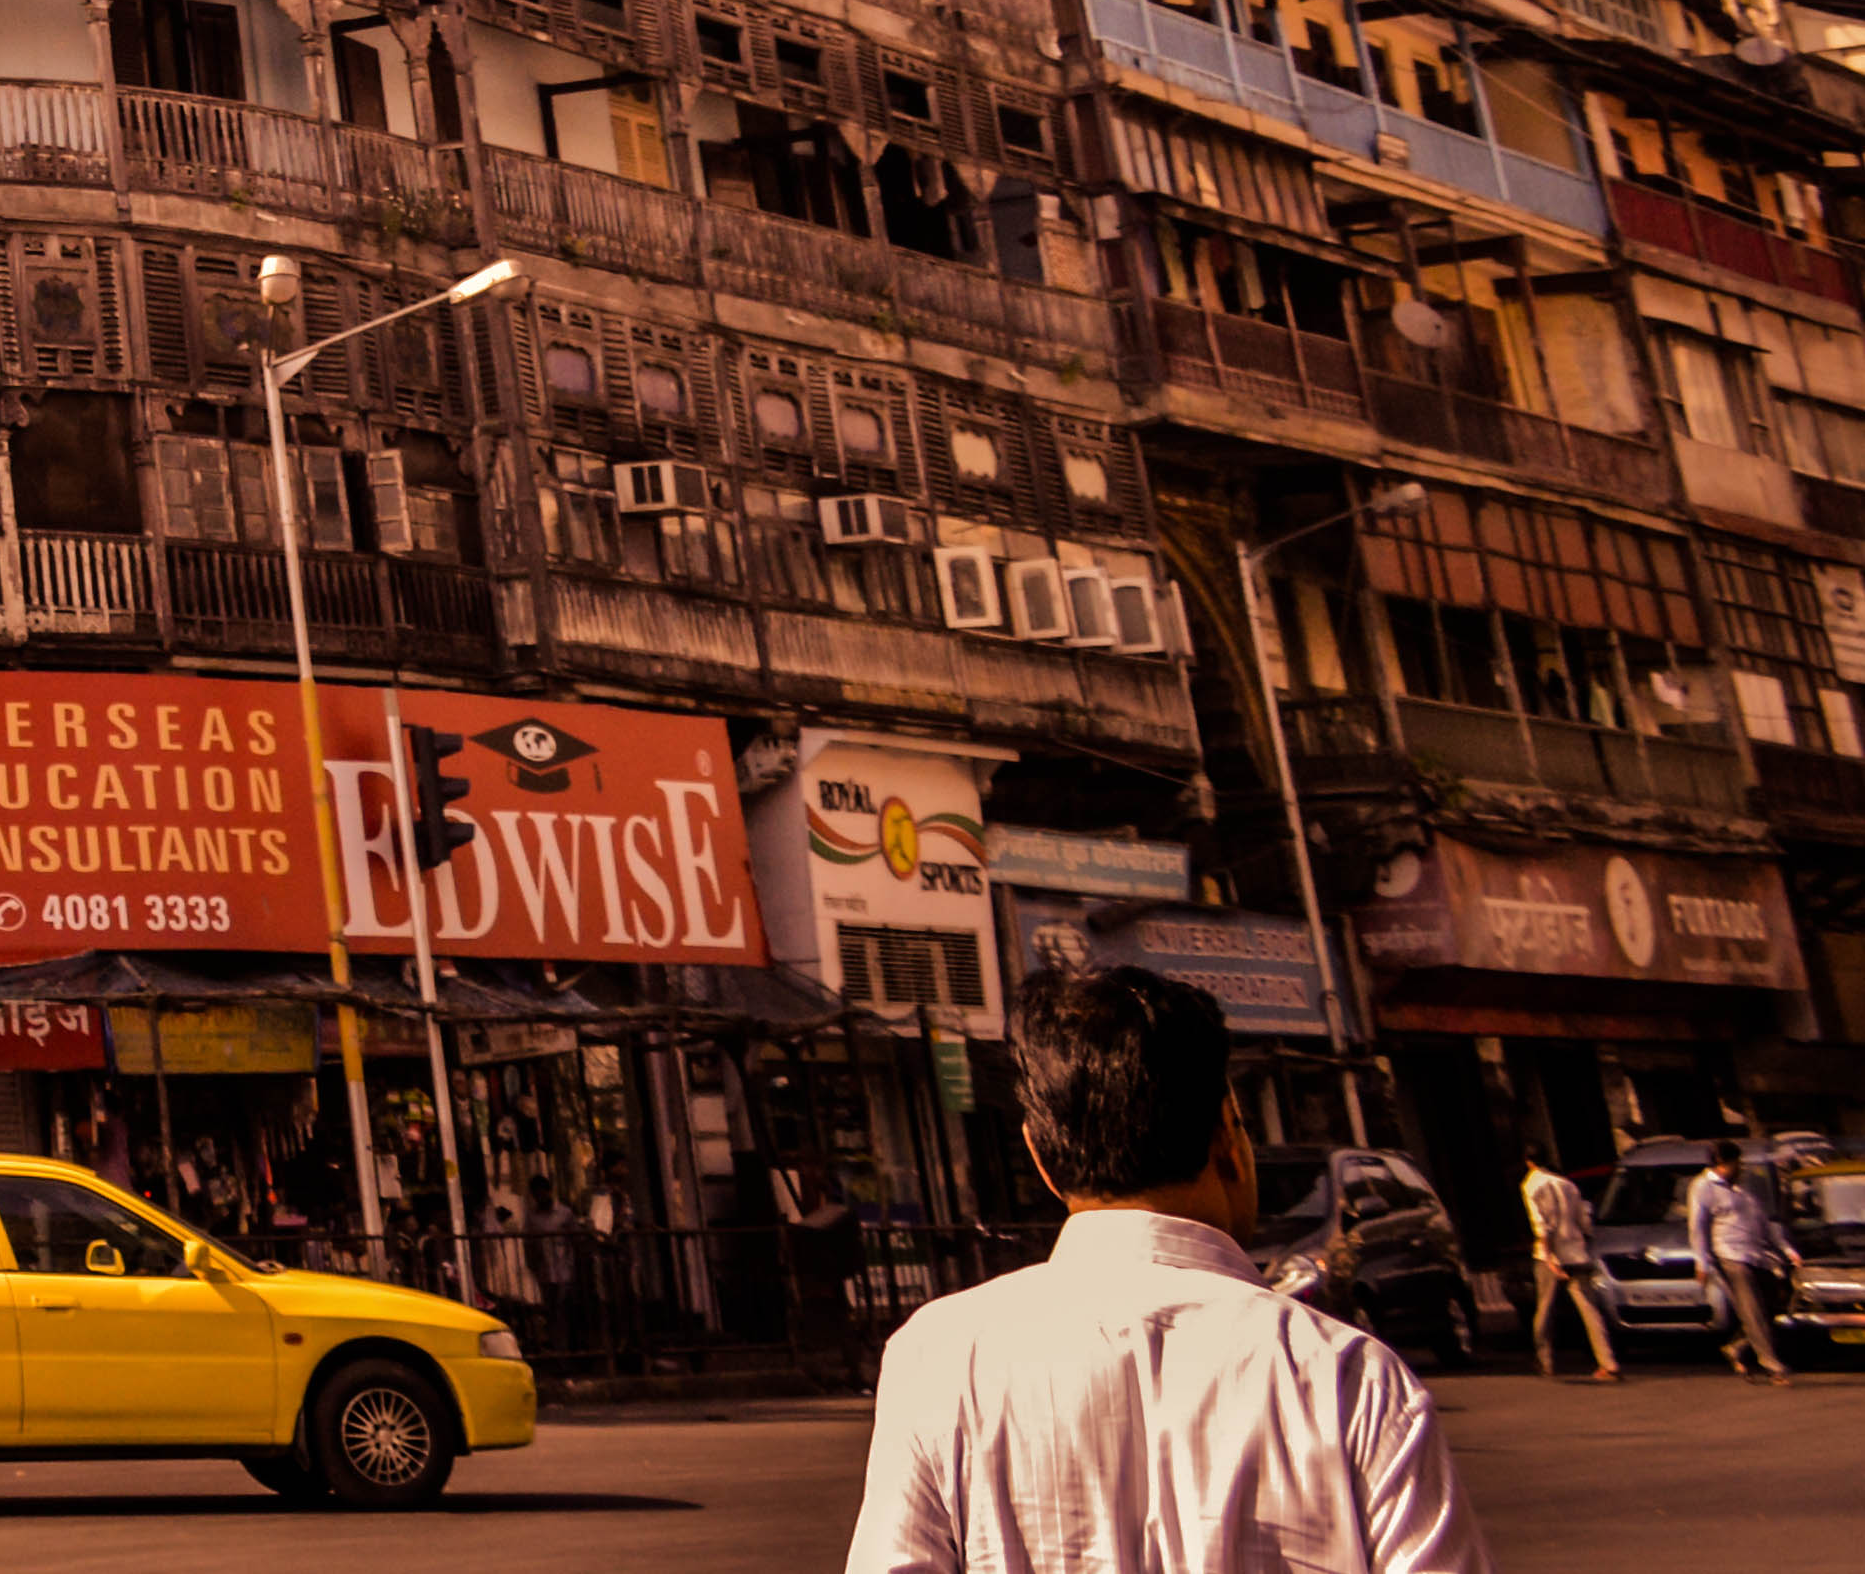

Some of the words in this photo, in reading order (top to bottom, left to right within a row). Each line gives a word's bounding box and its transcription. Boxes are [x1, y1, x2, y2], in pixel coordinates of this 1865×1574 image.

[819, 779, 878, 815] ROYAL
[323, 759, 746, 950] EDWISE
[921, 862, 983, 896] SPORTS
[41, 894, 130, 931] 4081
[144, 895, 231, 932] 3333
[1668, 893, 1767, 940] FURTADOS
